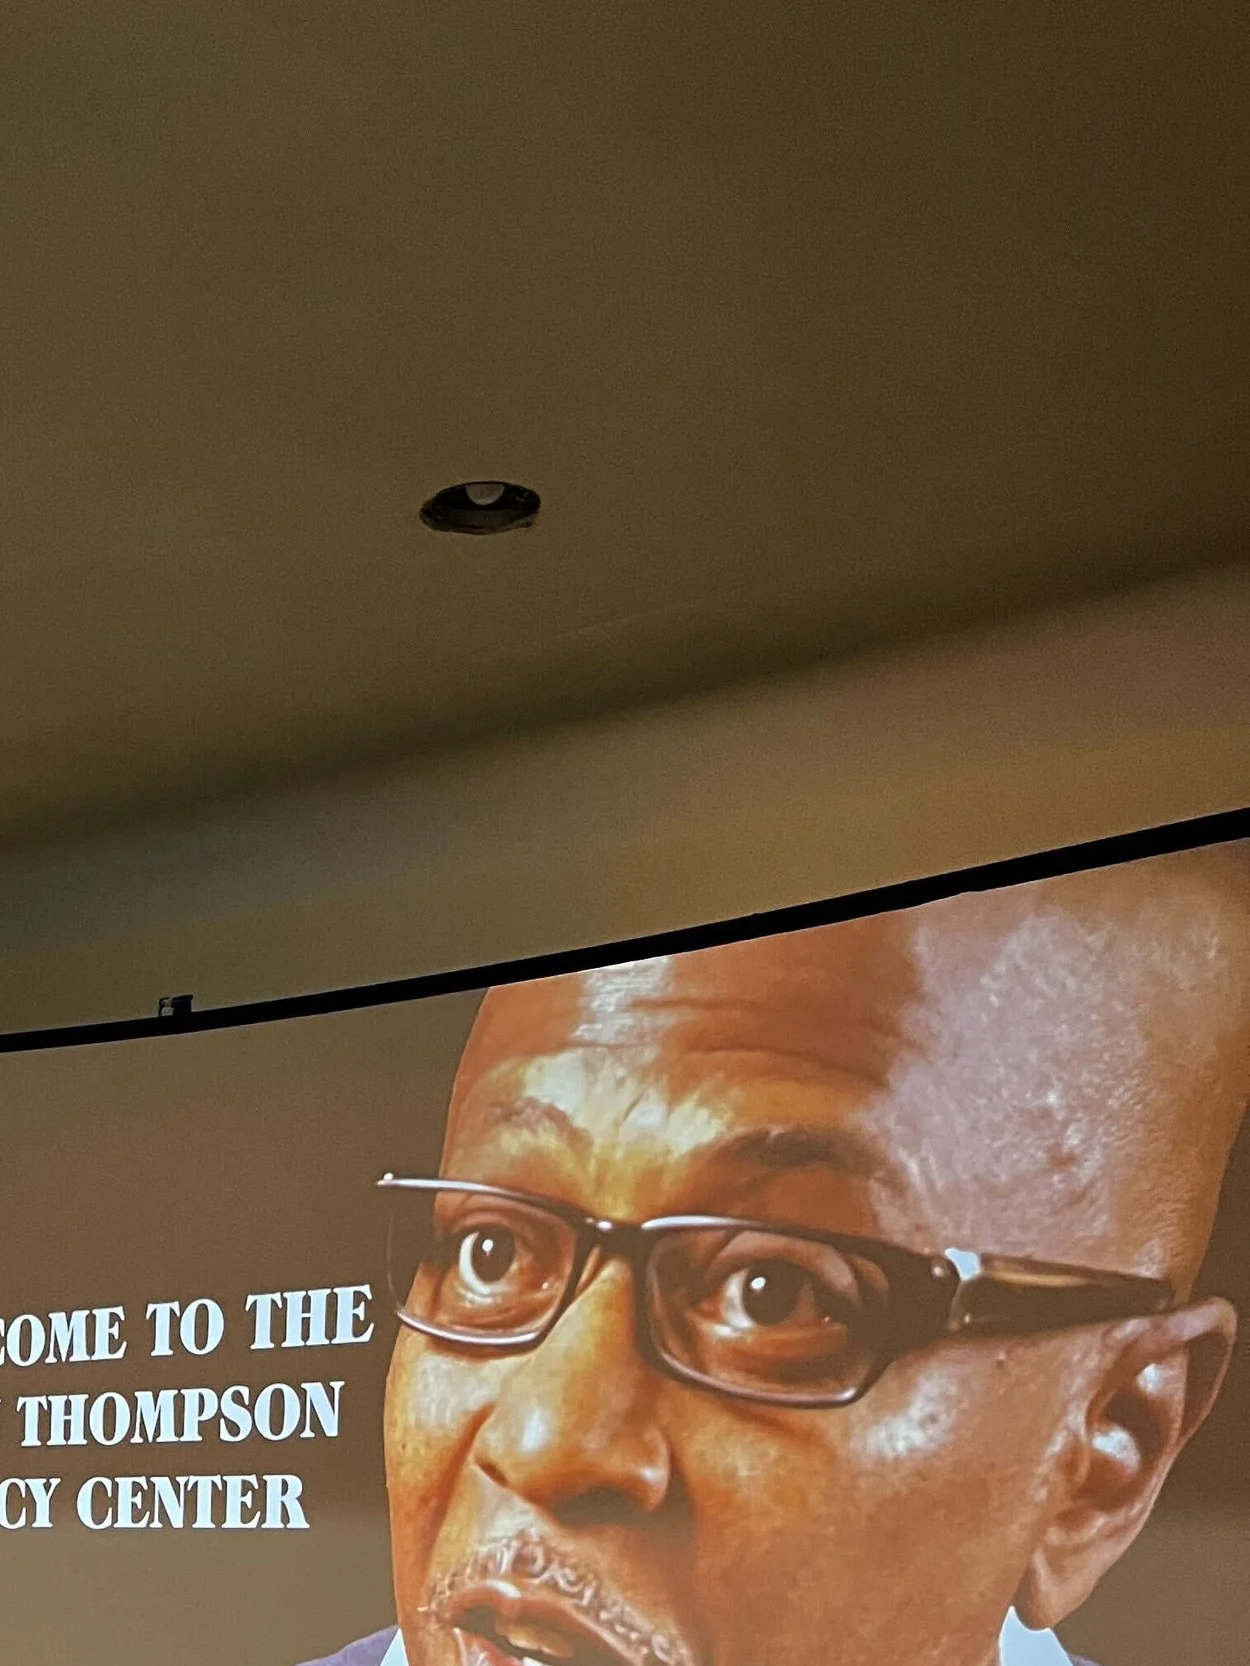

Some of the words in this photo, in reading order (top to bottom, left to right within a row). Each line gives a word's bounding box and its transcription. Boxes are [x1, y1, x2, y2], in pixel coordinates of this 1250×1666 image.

[145, 1298, 225, 1357] TO
[244, 1284, 375, 1350] THE
[16, 1380, 346, 1447] THOMPSON
[76, 1474, 311, 1530] CENTER
